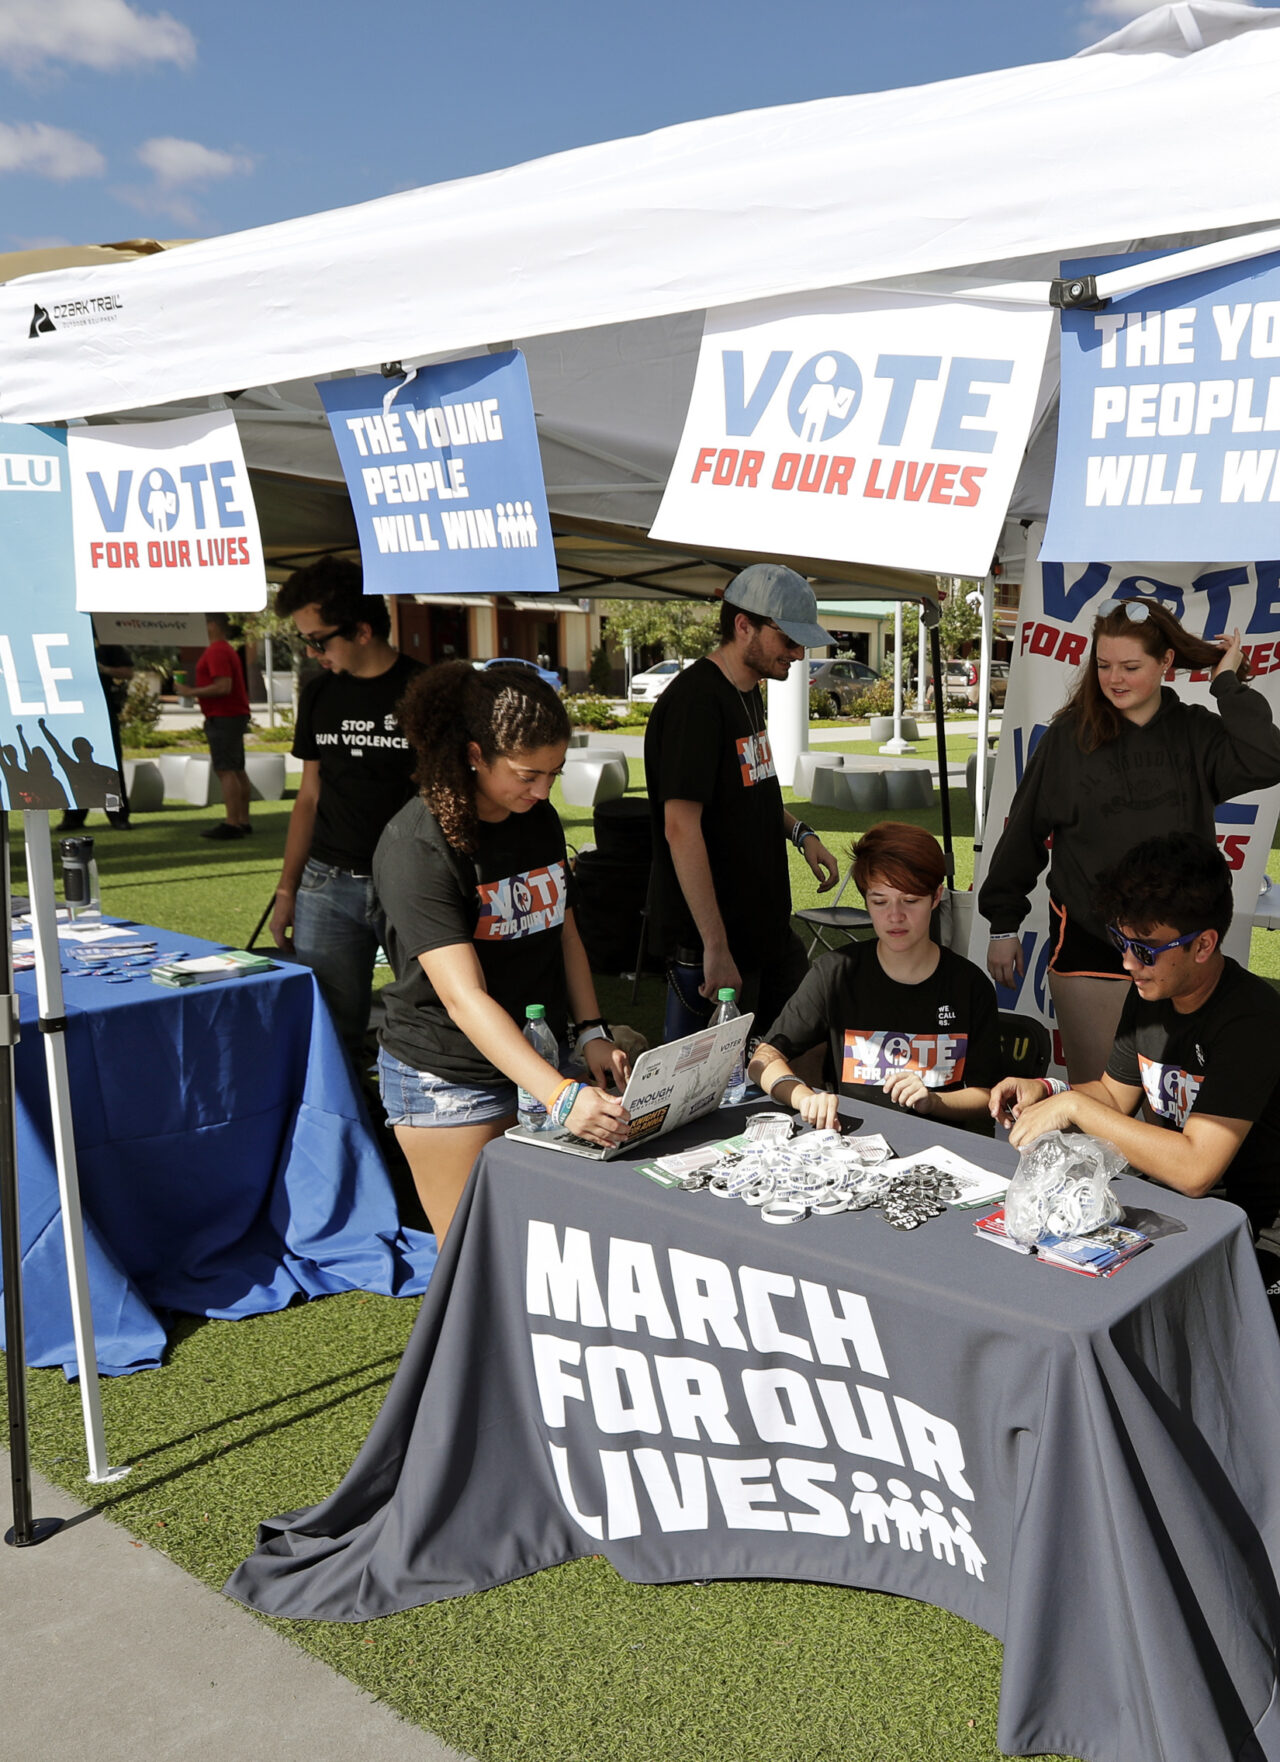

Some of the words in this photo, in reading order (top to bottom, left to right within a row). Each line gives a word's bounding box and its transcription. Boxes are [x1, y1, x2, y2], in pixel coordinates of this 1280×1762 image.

[1094, 307, 1197, 369] THE
[721, 350, 1015, 454] VOTE
[345, 412, 408, 457] THE
[405, 398, 504, 450] YOUNG
[86, 460, 245, 533] VOTE
[361, 458, 470, 506] PEOPLE
[690, 447, 765, 488] FOR
[771, 452, 856, 496] OUR
[863, 458, 988, 507] LIVES
[1085, 452, 1203, 507] WILL
[90, 541, 140, 568] FOR
[147, 540, 192, 568] OUR
[196, 536, 250, 567] LIVES
[372, 513, 440, 554] WILL
[440, 508, 498, 550] WIN
[1020, 621, 1088, 666] FOR
[341, 720, 376, 732] STOP
[341, 734, 409, 749] VIOLENCE
[489, 918, 518, 936] FOR
[850, 1036, 958, 1069] VOTE
[853, 1066, 882, 1081] FOR
[630, 1084, 675, 1109] ENOUGH
[526, 1219, 889, 1378] MARCH
[531, 1332, 740, 1445] FOR
[741, 1367, 975, 1502] OUR
[549, 1441, 851, 1540] LIVES
